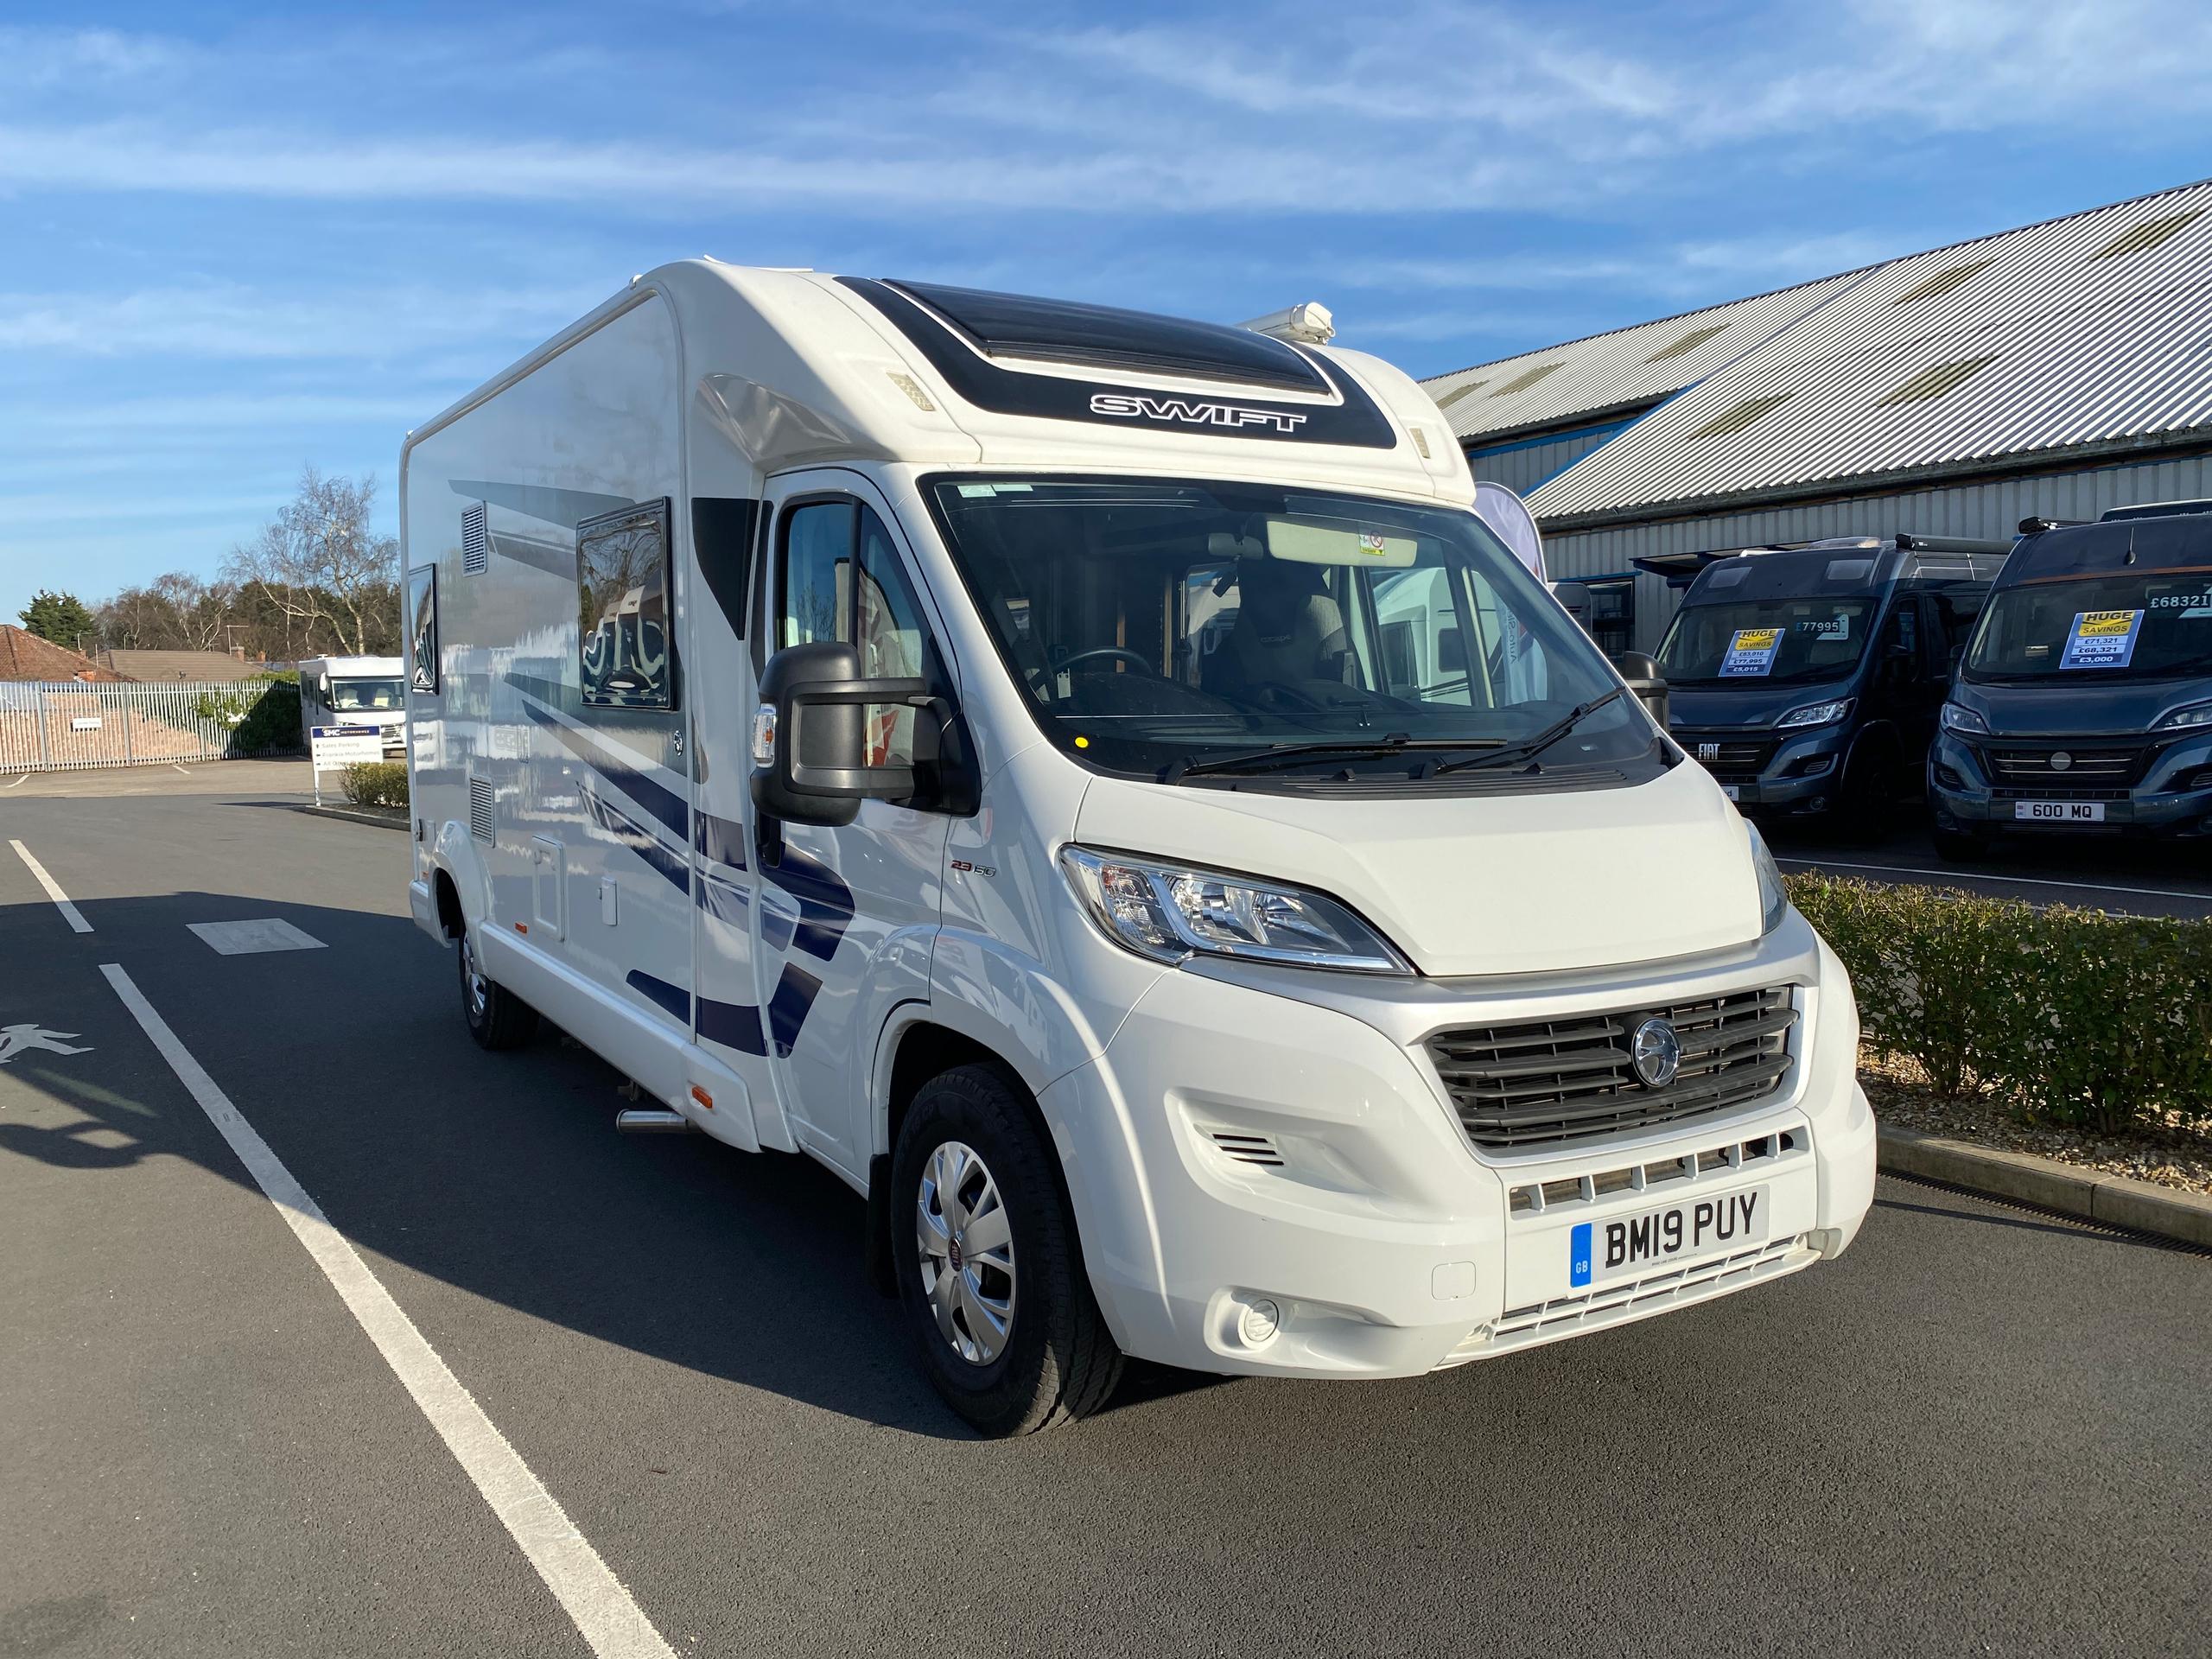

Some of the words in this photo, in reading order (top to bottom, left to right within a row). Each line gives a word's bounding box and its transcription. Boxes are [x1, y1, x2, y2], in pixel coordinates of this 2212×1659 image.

[1090, 394, 1307, 432] SWIFT
[2150, 595, 2209, 608] £68321
[2087, 612, 2133, 621] HUGE
[1698, 743, 1720, 760] FIAT
[2032, 804, 2063, 817] 600
[2071, 805, 2092, 818] MQ
[1605, 1209, 1683, 1268] BM19
[1694, 1192, 1758, 1247] PUY
[1575, 1260, 1588, 1274] GB
